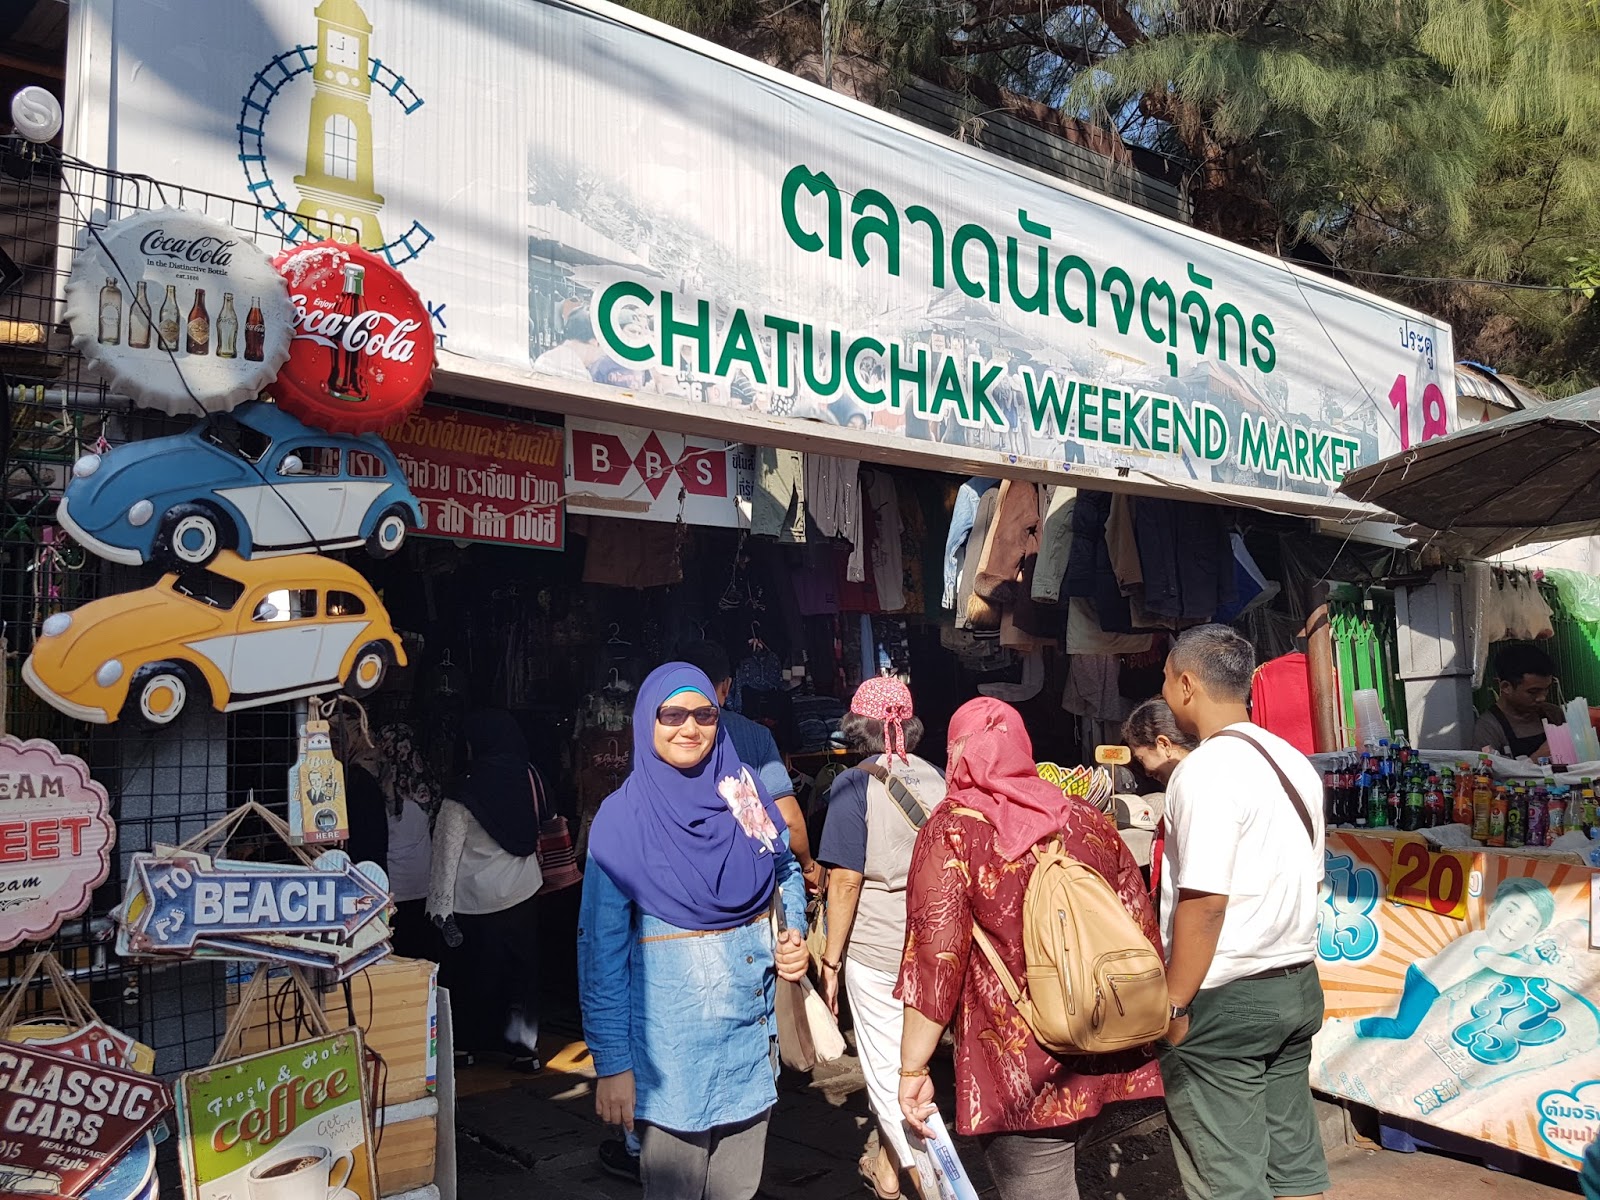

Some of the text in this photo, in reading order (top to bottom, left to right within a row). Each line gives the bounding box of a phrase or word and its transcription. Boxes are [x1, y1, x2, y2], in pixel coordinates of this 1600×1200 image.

[169, 262, 206, 273] Distinctive
[781, 164, 1277, 378] ตลาดนัดจตุจักร
[597, 281, 1358, 483] CHATUCHAK WEEKEND MARKET
[315, 831, 340, 840] HERE
[154, 867, 192, 900] TO
[1394, 842, 1464, 914] 20
[194, 881, 336, 925] BEACH
[207, 1077, 266, 1117] Fresh
[211, 1068, 350, 1153] coffee
[5, 1097, 105, 1147] CARS
[39, 1141, 108, 1160] REAL VINTAGE
[44, 1153, 90, 1171] Style
